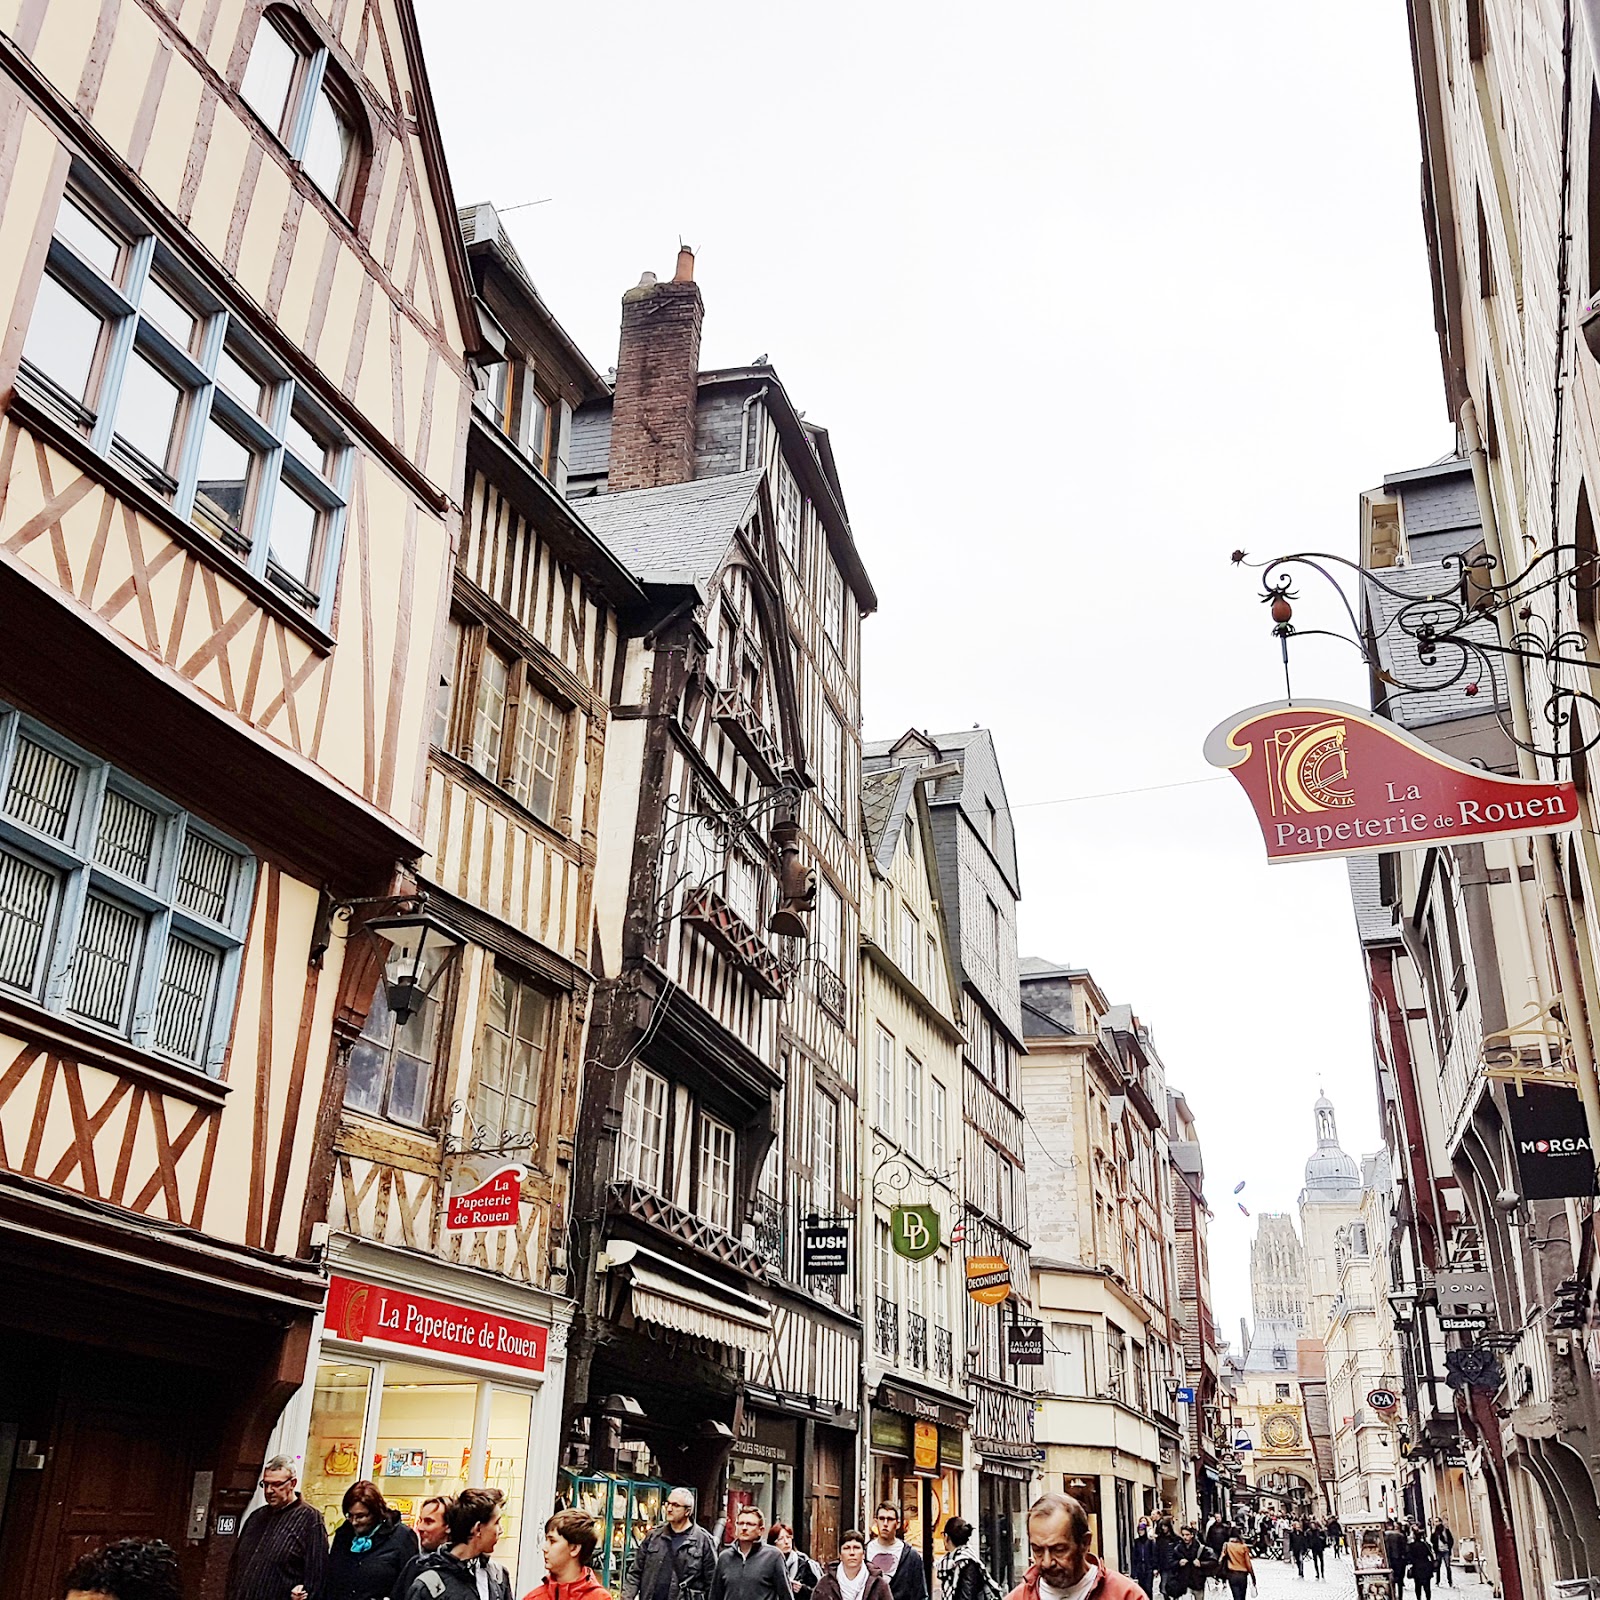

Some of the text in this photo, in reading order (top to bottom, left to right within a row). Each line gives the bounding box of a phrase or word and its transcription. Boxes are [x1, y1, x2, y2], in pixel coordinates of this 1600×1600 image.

[1385, 781, 1422, 804] La
[1274, 793, 1567, 849] Papeterie de Rouen
[494, 1180, 509, 1191] La
[456, 1194, 512, 1211] Papeterie
[454, 1211, 509, 1225] de Rouen
[807, 1236, 847, 1249] LUSH
[967, 1271, 1009, 1289] DECONIHOUT
[1441, 1284, 1486, 1294] JONA
[378, 1298, 537, 1359] La Papeterie de Rouen
[1442, 1319, 1486, 1330] Bizzbee
[740, 1410, 756, 1438] SH
[220, 1518, 234, 1531] 148
